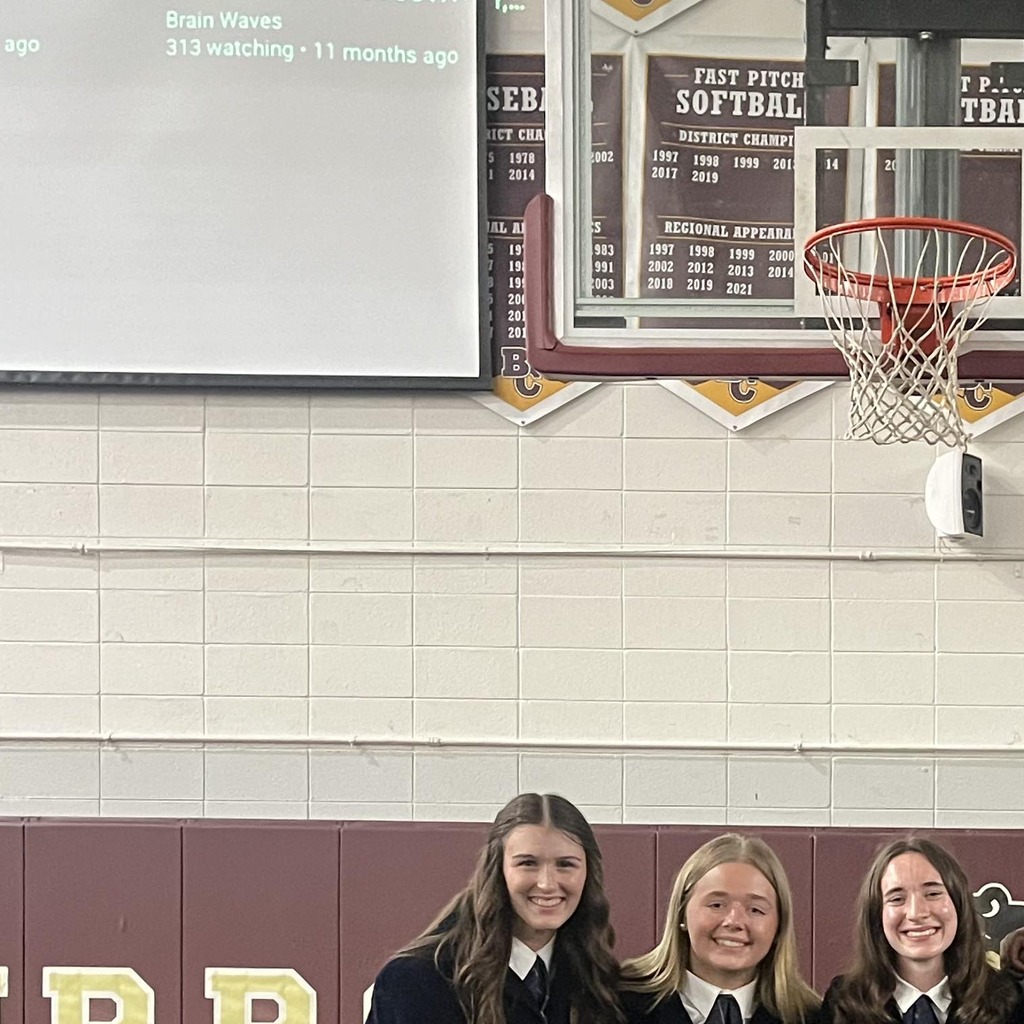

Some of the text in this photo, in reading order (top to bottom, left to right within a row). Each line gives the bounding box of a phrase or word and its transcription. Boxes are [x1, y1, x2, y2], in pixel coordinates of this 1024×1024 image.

[166, 10, 282, 30] Brain Waves
[4, 38, 40, 57] ago
[166, 38, 459, 69] 313 watching 11 months ago
[694, 67, 804, 88] FAST PITCH
[676, 89, 802, 118] SOFTBAL
[679, 130, 794, 147] DISTRICT CHAMPI
[510, 152, 535, 164] 1978
[653, 149, 678, 163] 1997
[694, 154, 719, 168] 1998
[734, 157, 759, 168] 1999
[773, 158, 795, 170] 201
[508, 168, 535, 180] 2014
[651, 167, 719, 183] 2017 2019
[664, 221, 729, 238] REGIONAL
[650, 243, 674, 256] 1997
[689, 245, 715, 258] 1998
[729, 249, 755, 261] 1999
[769, 250, 794, 262] 2000
[648, 260, 794, 279] 2002 2012 2013 2014
[647, 277, 752, 295] 2018 2019 2021
